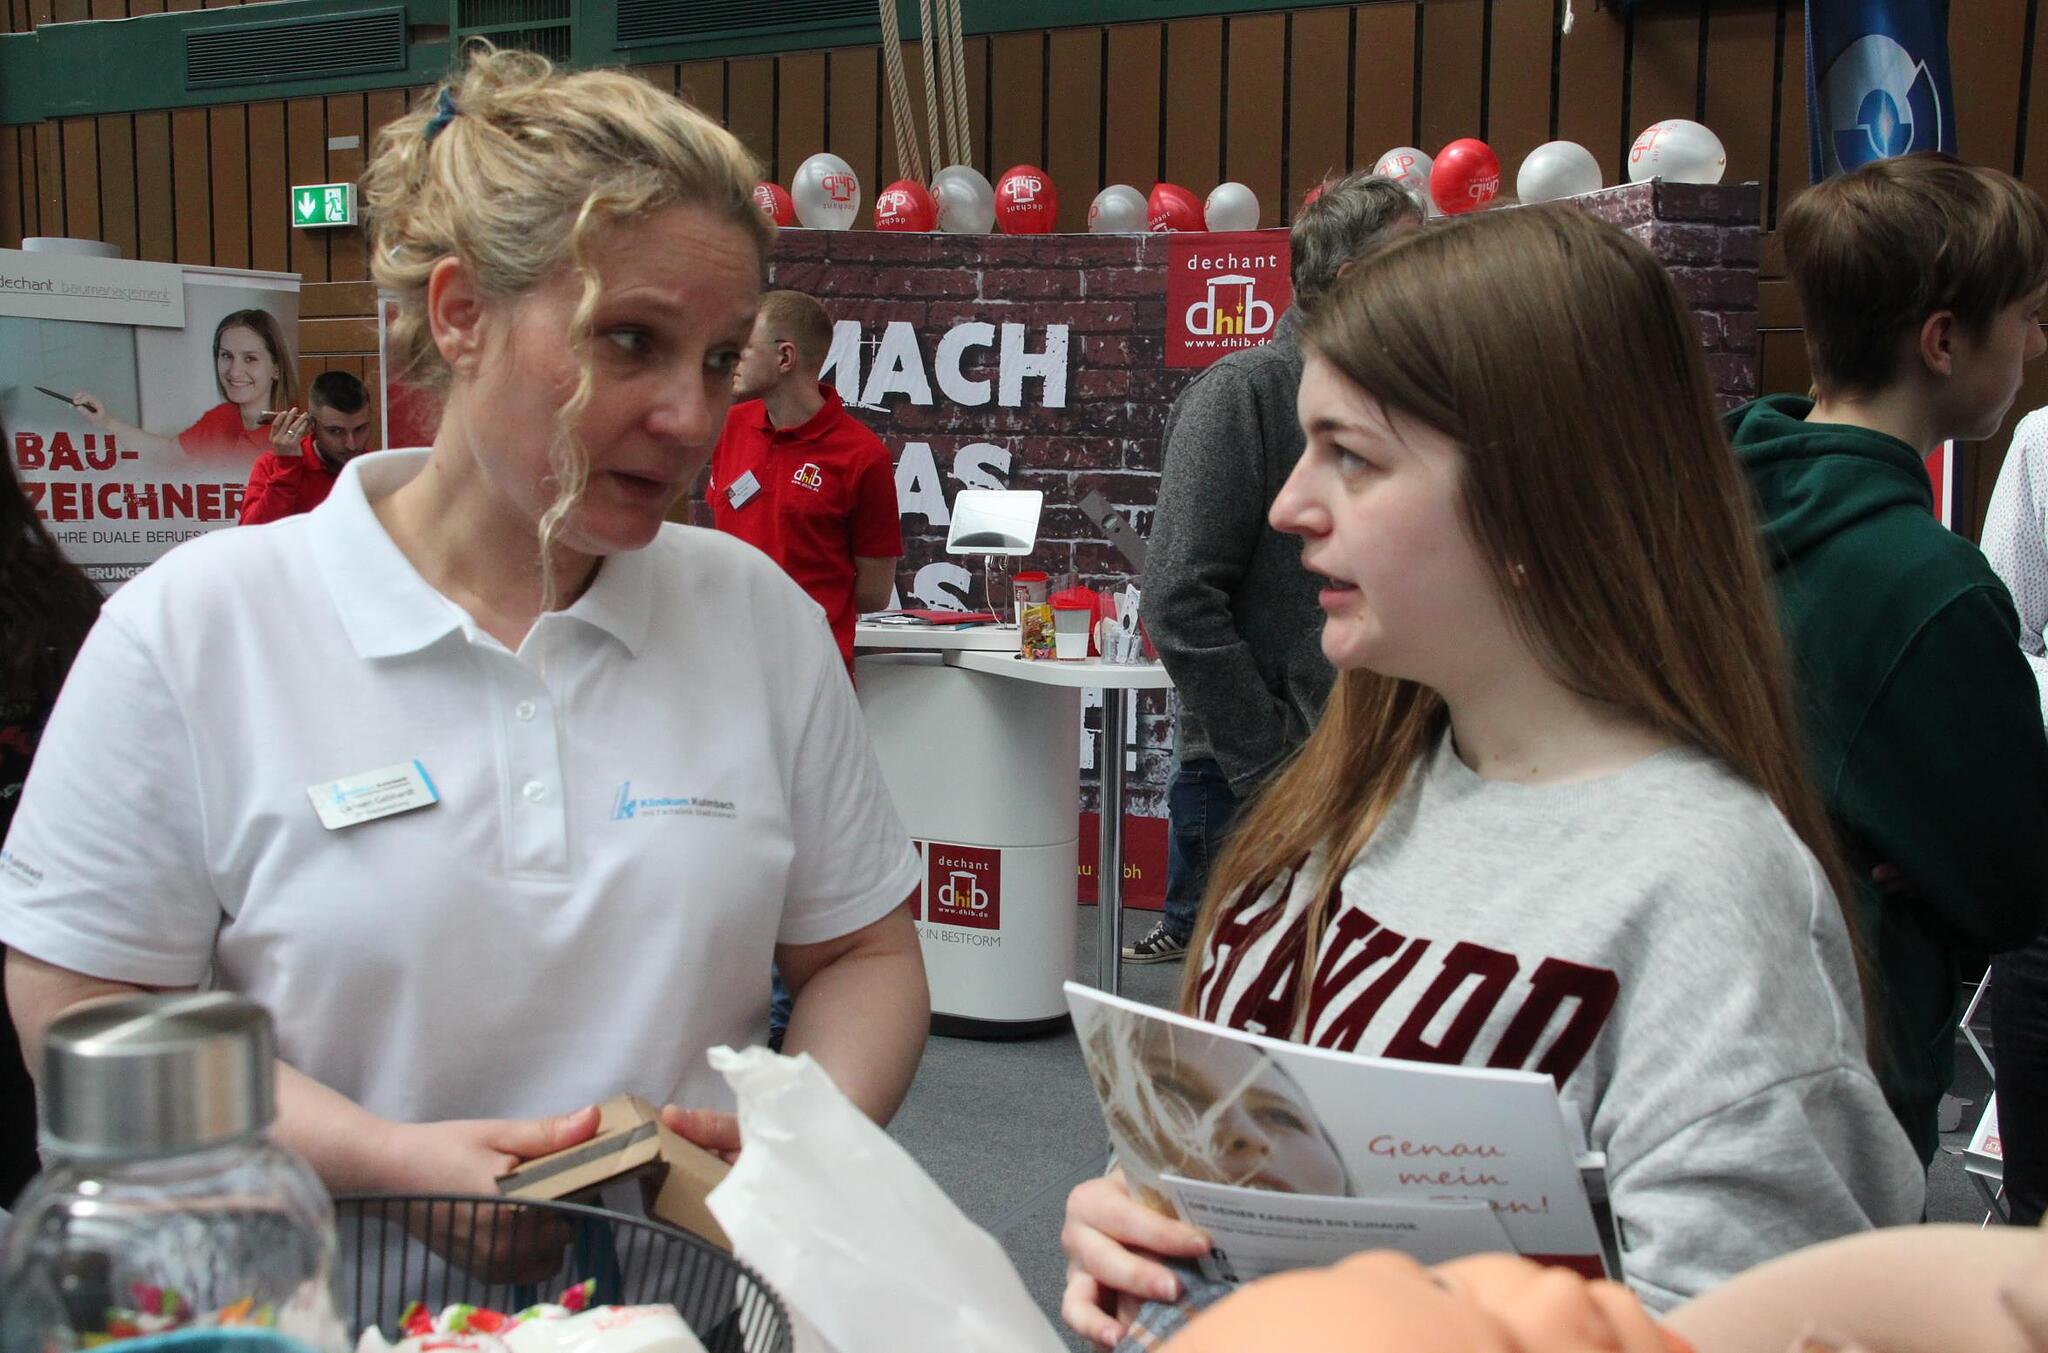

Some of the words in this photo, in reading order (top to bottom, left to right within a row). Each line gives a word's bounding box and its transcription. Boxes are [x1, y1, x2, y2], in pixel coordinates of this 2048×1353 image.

[1187, 253, 1276, 270] dechant
[1185, 275, 1275, 335] dhib
[15, 432, 139, 471] BAU-
[894, 442, 1012, 525] AS
[57, 531, 87, 544] HRE
[93, 530, 140, 544] DUALE
[146, 530, 207, 543] BERUFS
[938, 855, 989, 871] dechant
[938, 872, 989, 910] dhib
[941, 931, 1000, 947] BESTFORM
[1368, 1134, 1505, 1158] Genau
[1399, 1167, 1508, 1187] mein
